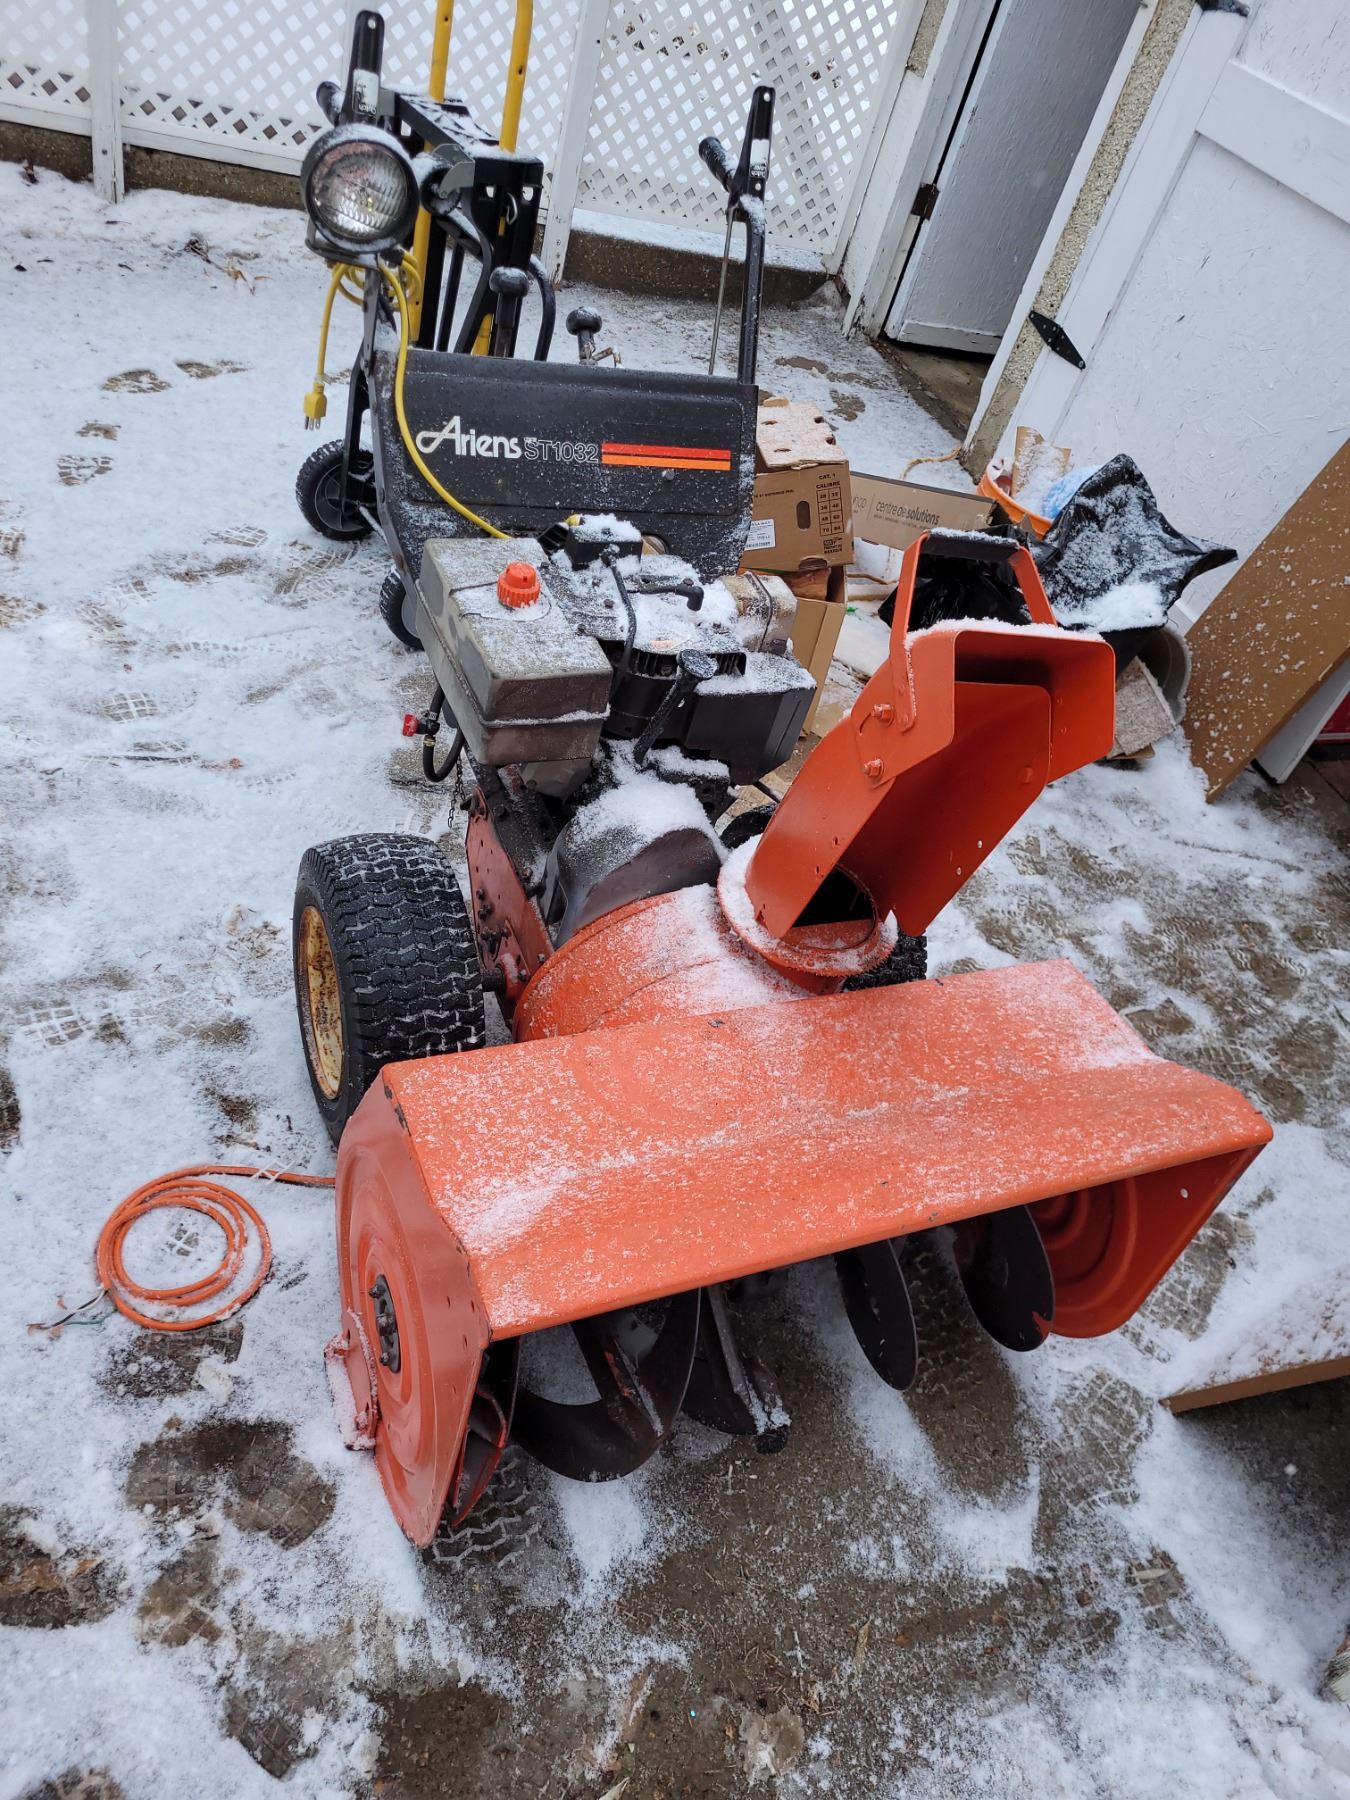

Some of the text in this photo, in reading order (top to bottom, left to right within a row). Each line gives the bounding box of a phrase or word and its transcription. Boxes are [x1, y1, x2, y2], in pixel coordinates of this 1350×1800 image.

[416, 415, 599, 464] Ariens ST1032
[816, 480, 841, 489] CALIBRE
[875, 500, 897, 515] centre
[906, 505, 941, 526] solutions
